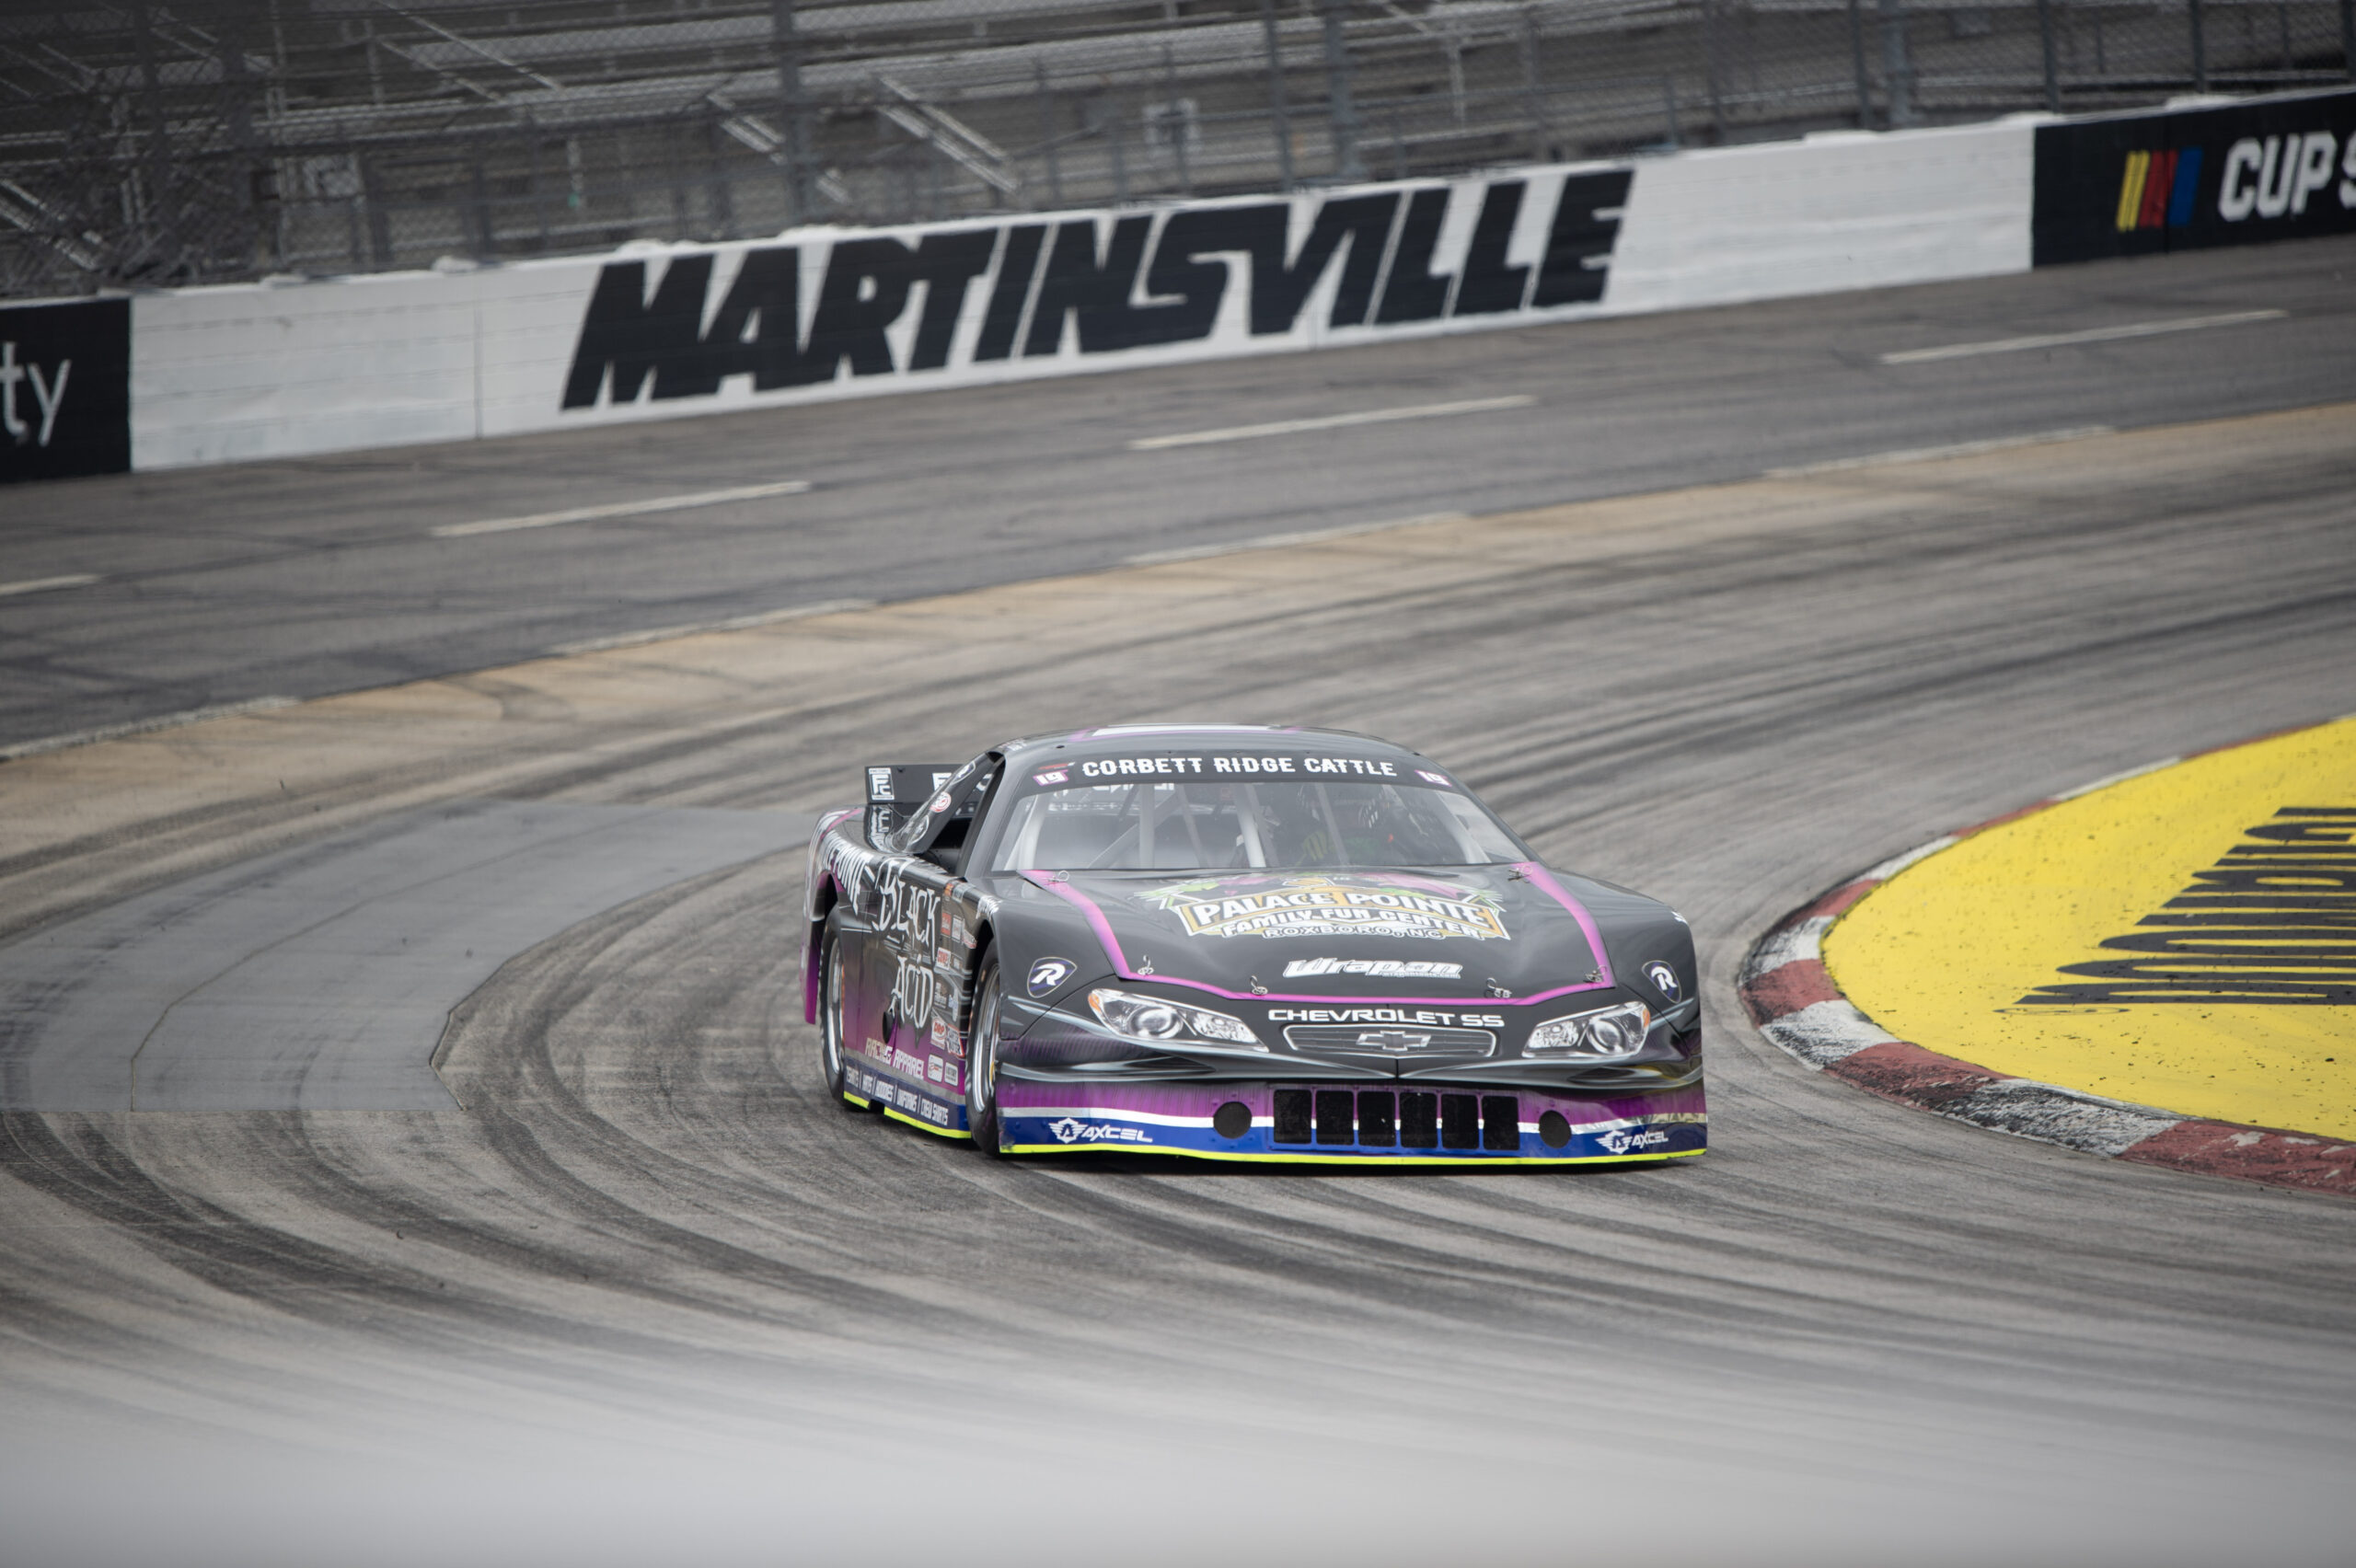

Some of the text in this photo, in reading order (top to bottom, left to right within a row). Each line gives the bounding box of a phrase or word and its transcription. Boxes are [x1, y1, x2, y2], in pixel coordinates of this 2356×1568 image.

[2218, 130, 2338, 222] CUP
[560, 167, 1634, 411] MARTINSVILLE
[1081, 756, 1398, 777] CORBETT RIDGE CATTLE
[1191, 891, 1492, 929] PALACE POINTE
[1221, 907, 1486, 940] FAMILY FUN CENTER
[1263, 925, 1446, 940] ROXBORO, NC
[1268, 1009, 1505, 1027] CHEVROLET SS
[893, 1049, 924, 1080] APPAREL
[1080, 1124, 1153, 1143] AXCEL
[1631, 1131, 1669, 1149] AXCEL
